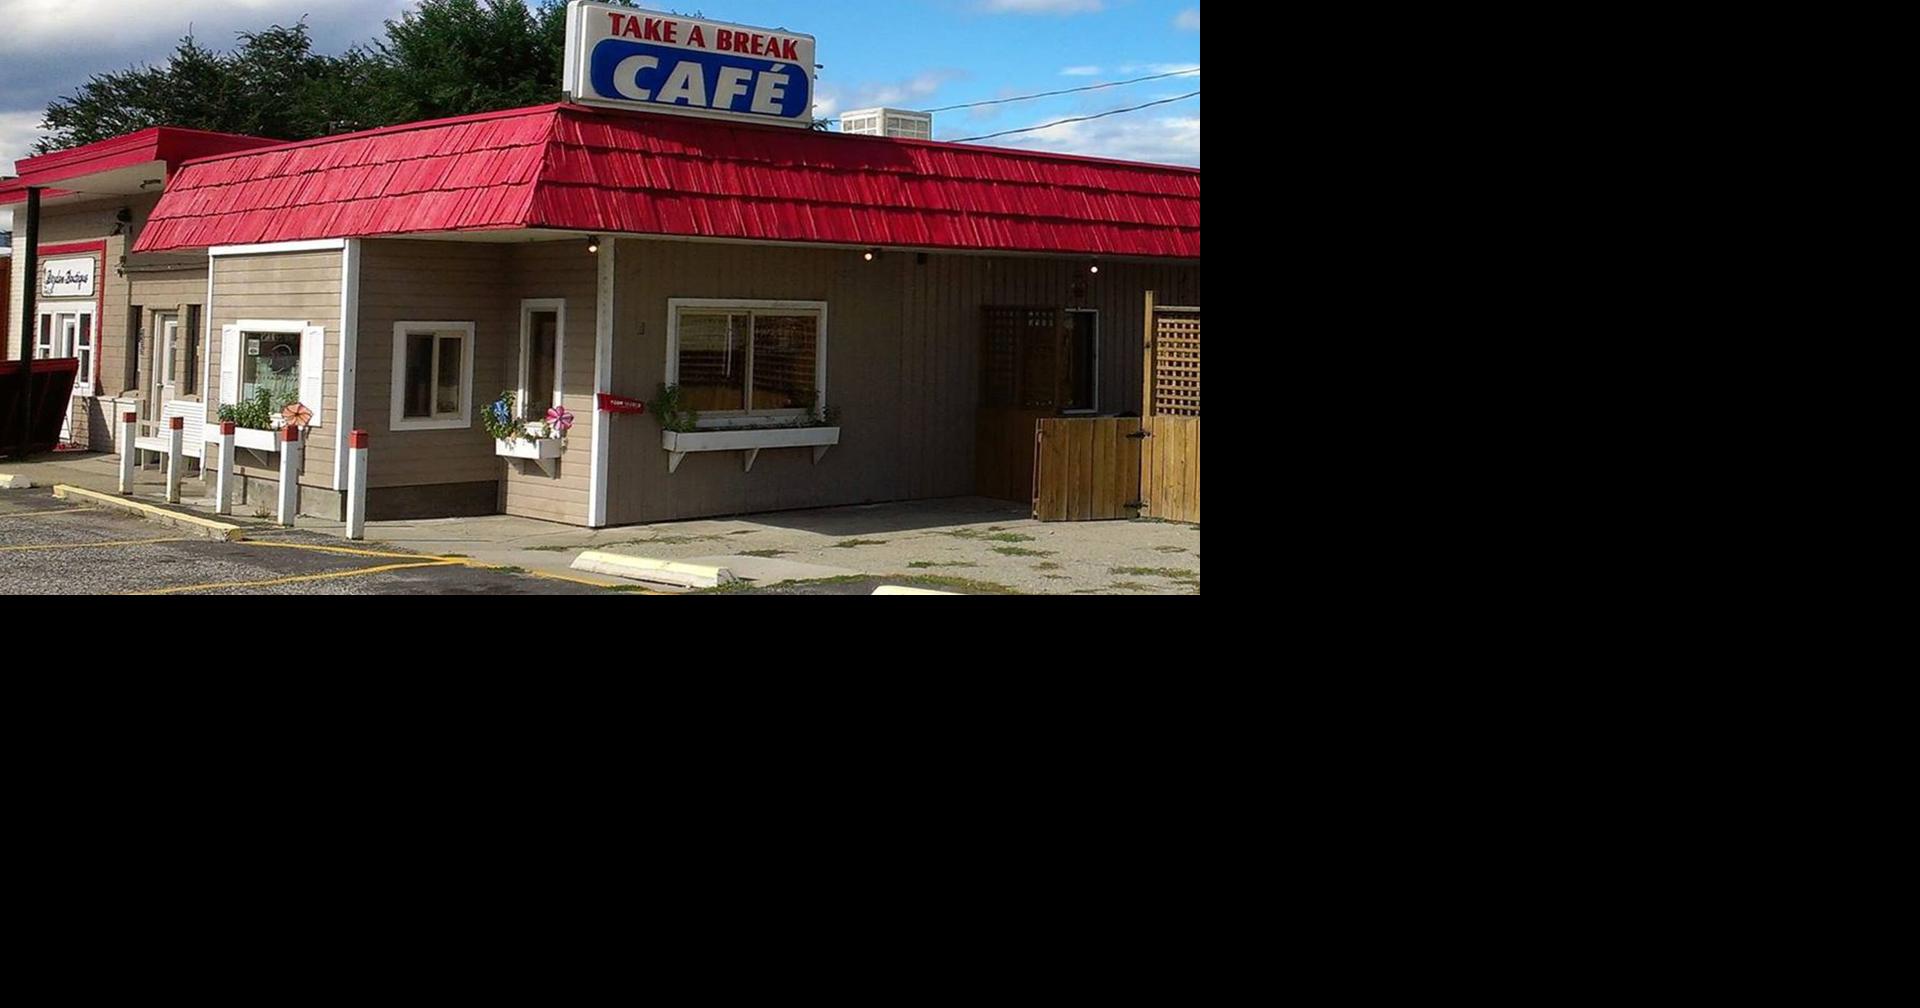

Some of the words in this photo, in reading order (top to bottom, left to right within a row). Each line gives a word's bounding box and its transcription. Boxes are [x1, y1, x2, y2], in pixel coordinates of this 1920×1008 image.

[608, 12, 677, 44] TAKE
[687, 25, 706, 48] A
[716, 29, 798, 61] BREAK
[613, 54, 789, 115] CAFÉ
